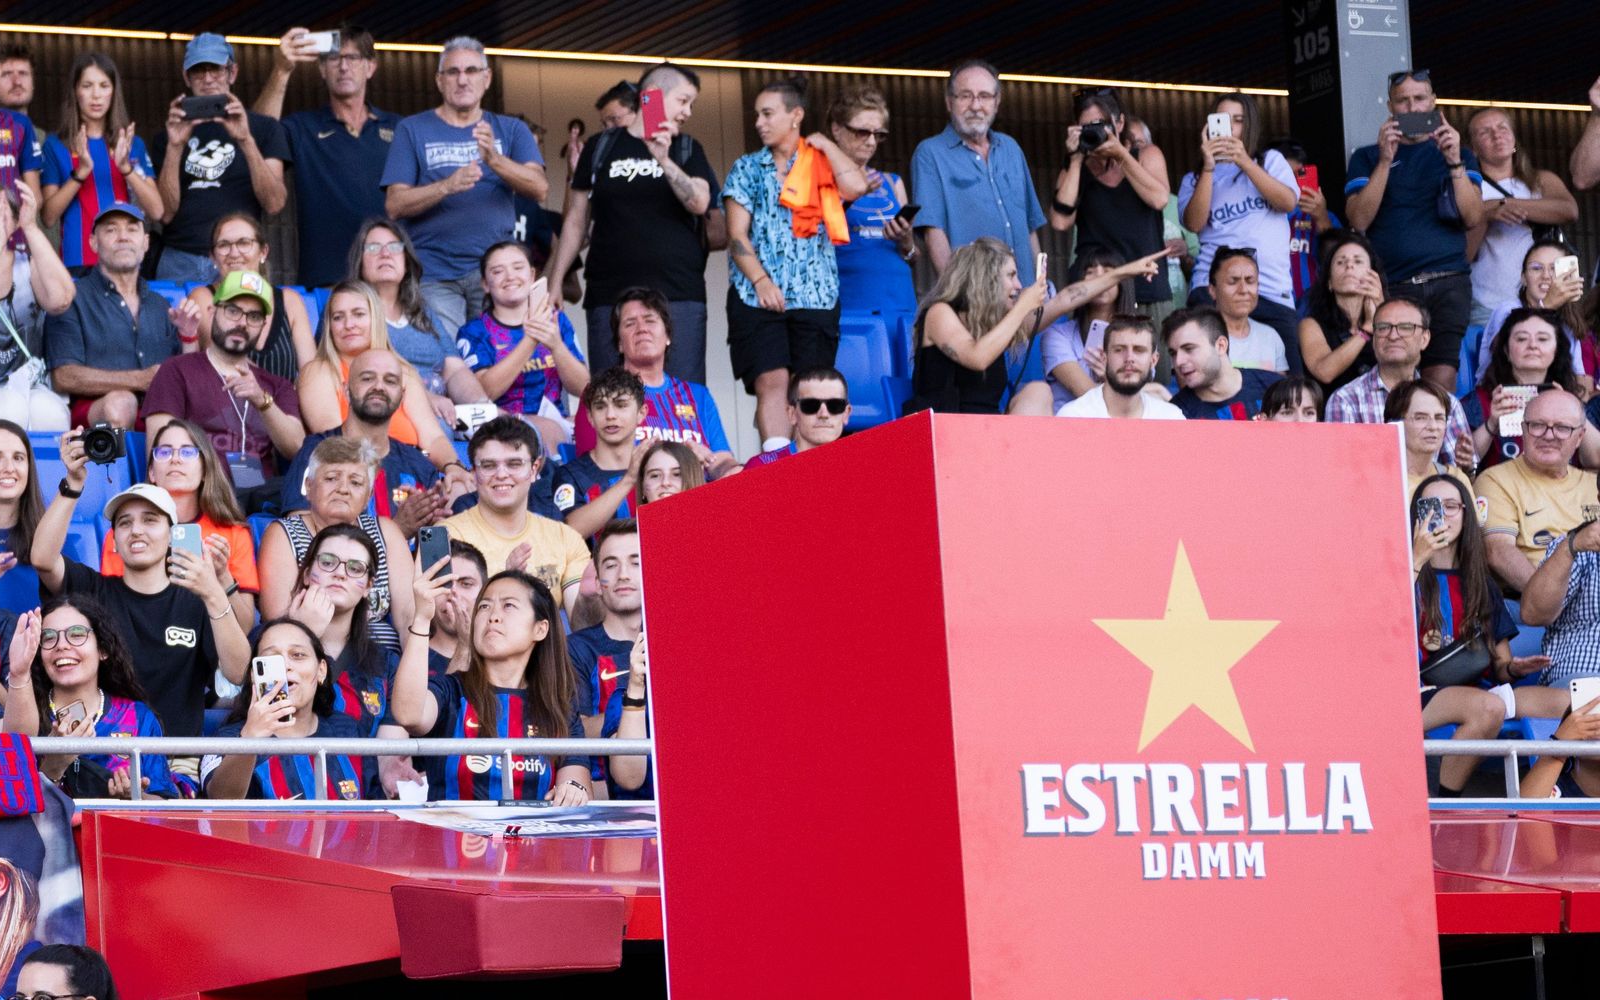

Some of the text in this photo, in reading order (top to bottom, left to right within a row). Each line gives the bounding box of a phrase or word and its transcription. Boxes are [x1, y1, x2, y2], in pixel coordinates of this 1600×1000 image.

[1293, 26, 1330, 64] 105
[1212, 196, 1274, 224] akute
[635, 426, 701, 443] STANLEY
[1021, 763, 1374, 838] ESTRELLA
[1141, 841, 1266, 880] DAMM
